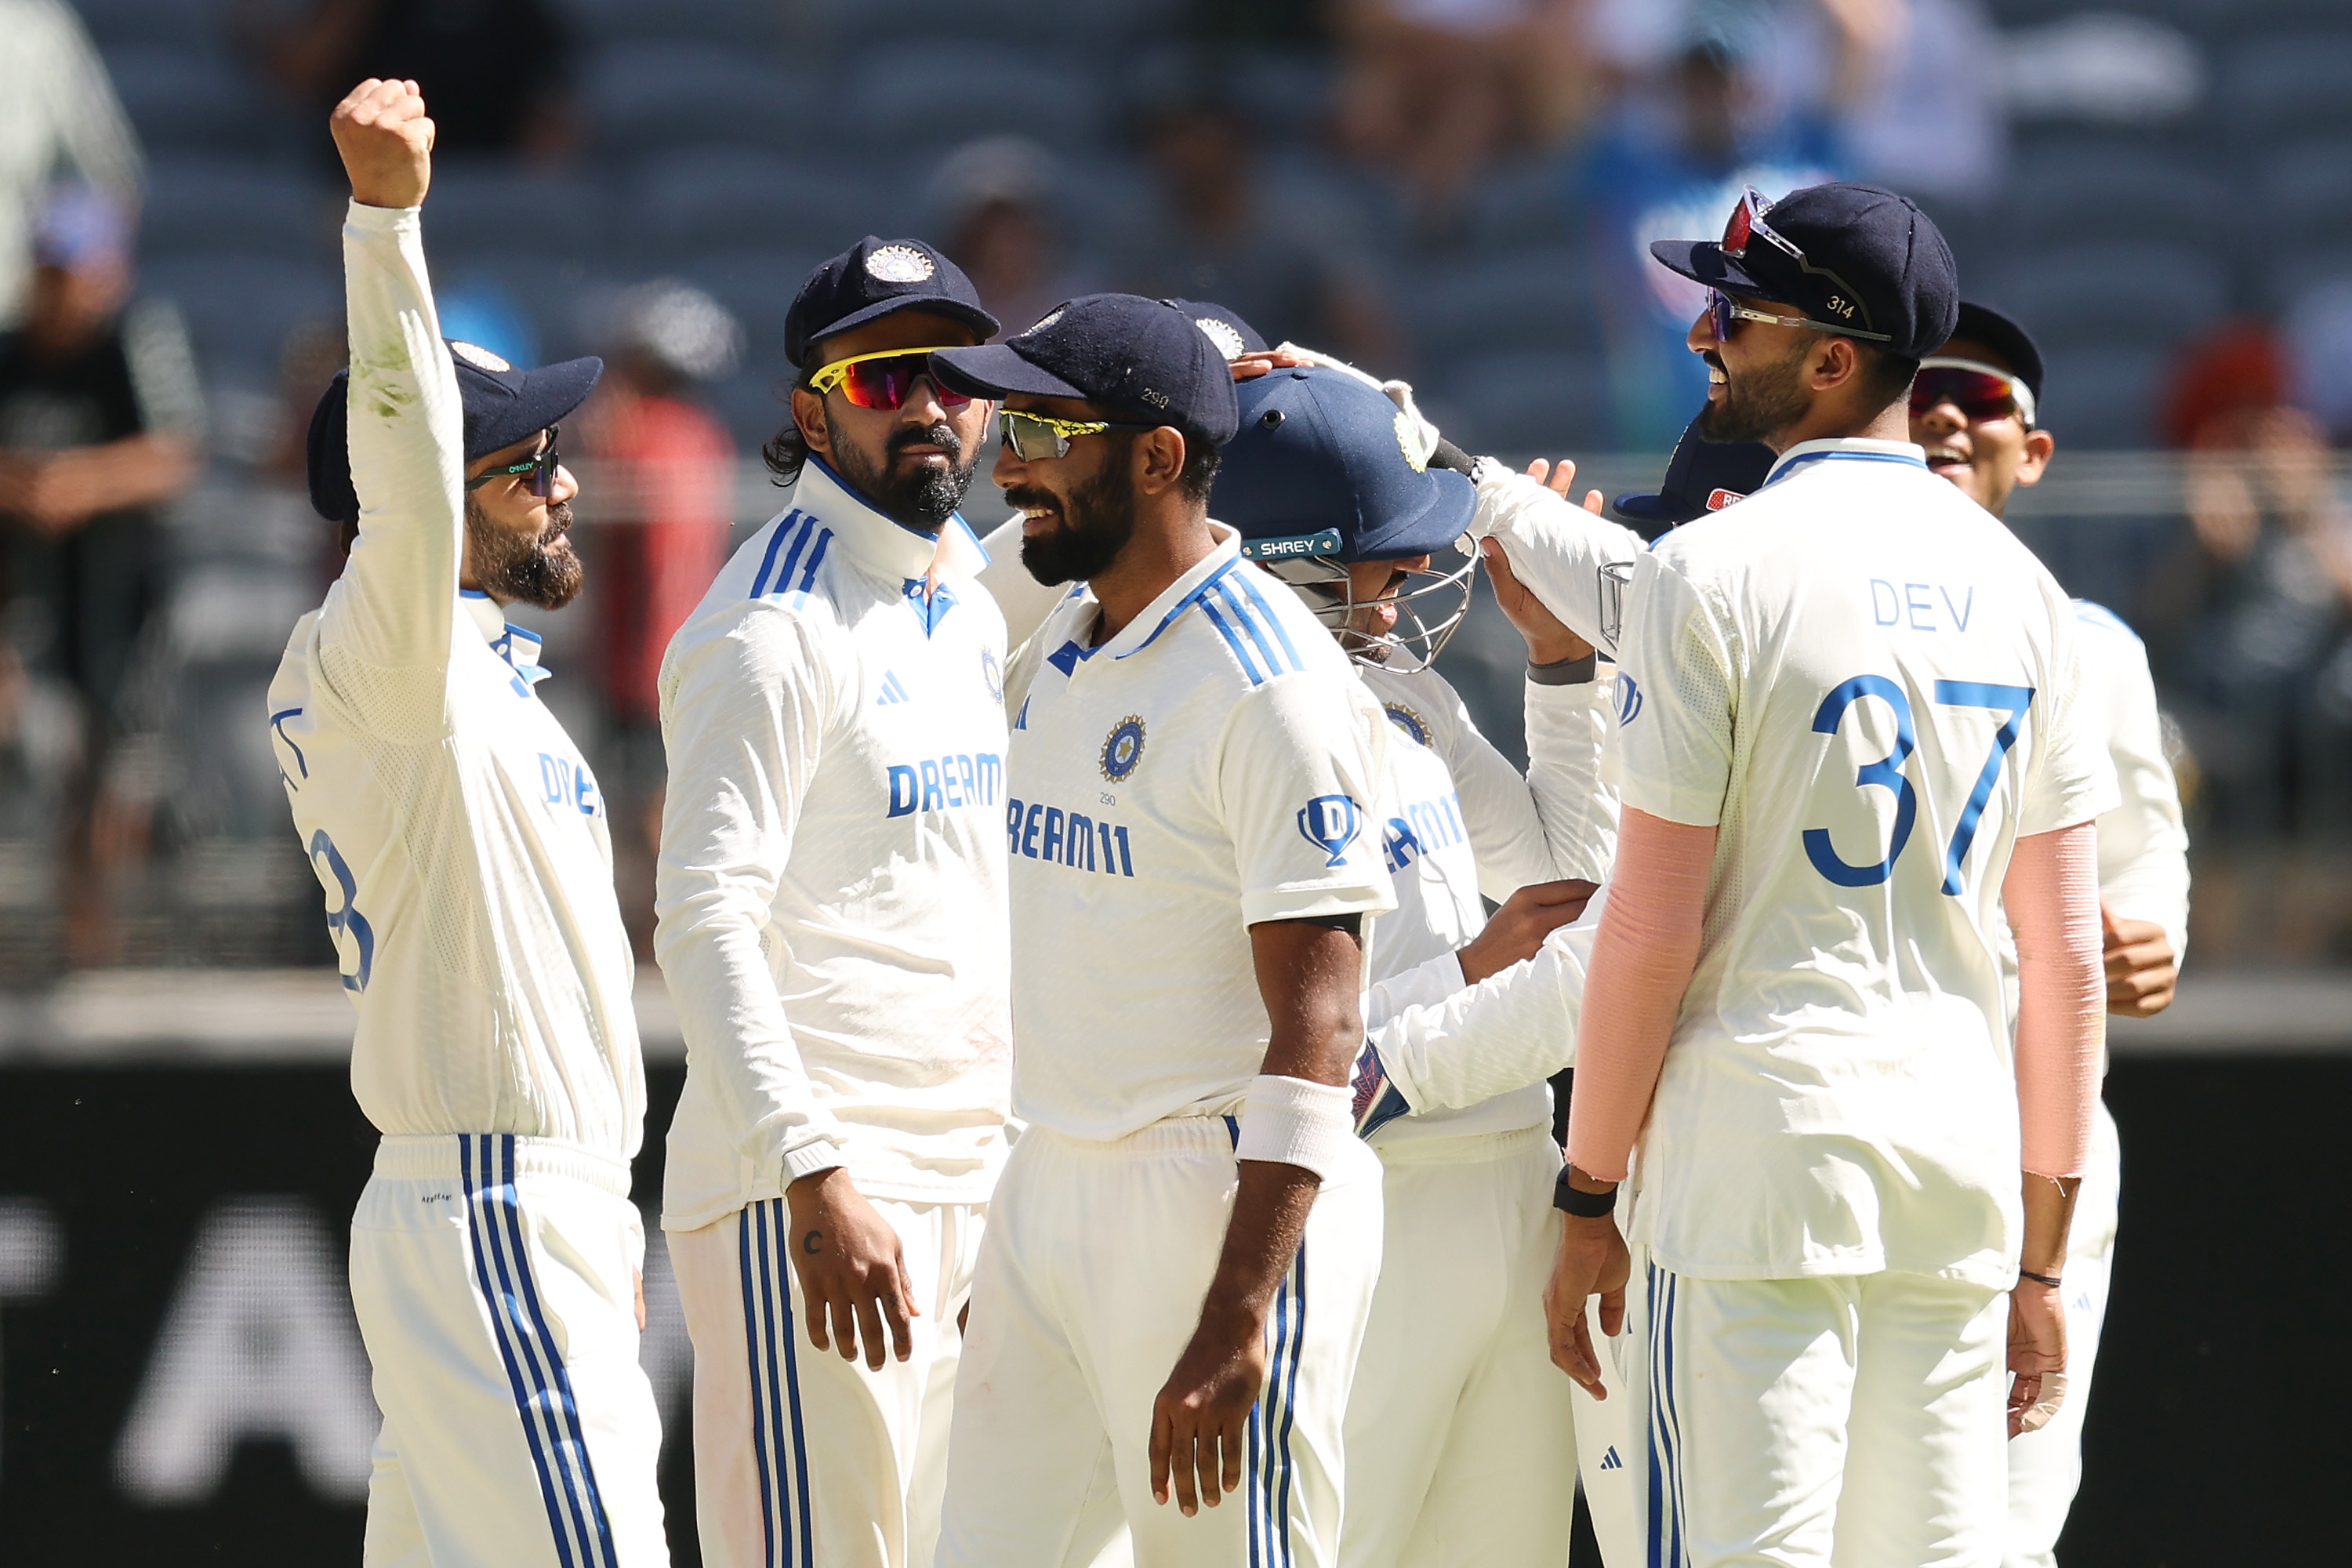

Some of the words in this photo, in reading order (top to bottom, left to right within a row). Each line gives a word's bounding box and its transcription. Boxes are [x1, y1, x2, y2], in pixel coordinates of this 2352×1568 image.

[1827, 295, 1855, 319] 314
[1141, 387, 1169, 410] 290
[1260, 539, 1315, 556] SHREY
[1869, 578, 1973, 633] DEV
[1802, 674, 2036, 896] 37
[1099, 791, 1116, 807] 290
